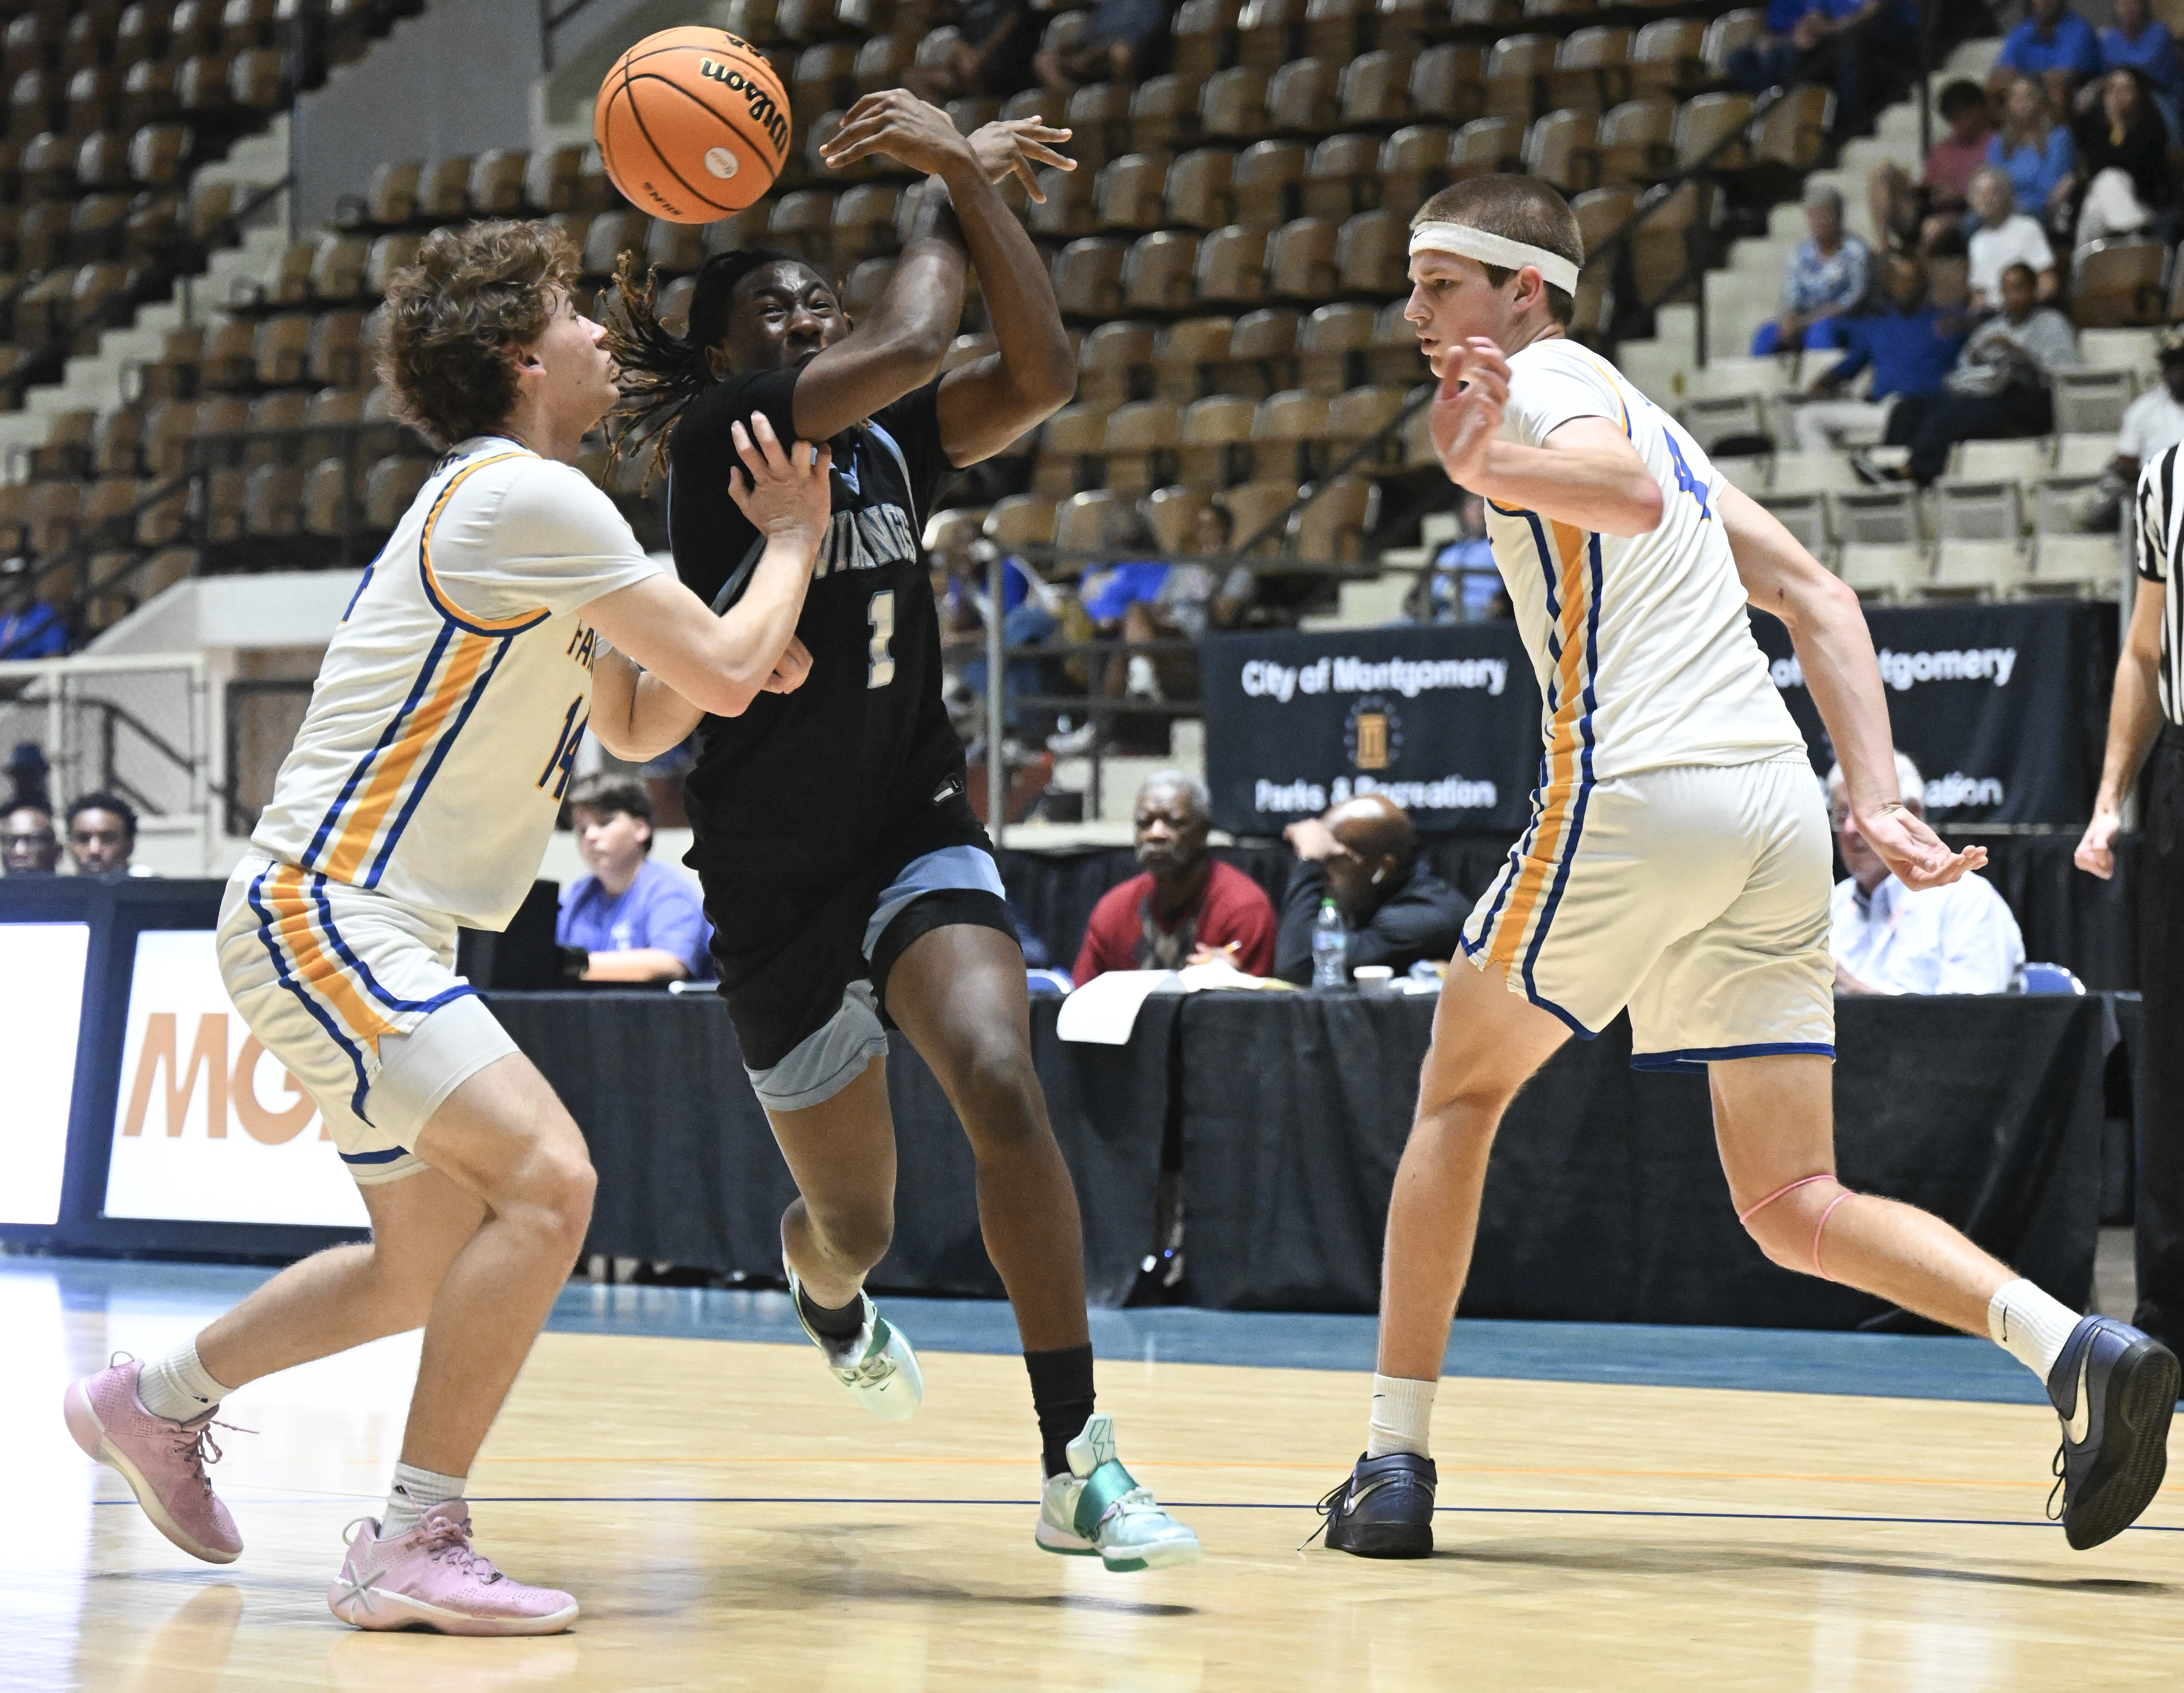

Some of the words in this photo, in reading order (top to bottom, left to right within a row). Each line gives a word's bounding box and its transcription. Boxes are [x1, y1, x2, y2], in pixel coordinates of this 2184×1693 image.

[700, 56, 788, 157] Wilson
[1661, 424, 1713, 523] 4
[867, 589, 895, 689] 1
[1241, 660, 1299, 703] City
[1299, 656, 1330, 695] of
[1333, 656, 1510, 698] Montgomery
[1877, 647, 2017, 691] tgomery
[1255, 777, 1327, 812] Parks
[122, 1012, 332, 1145] MG
